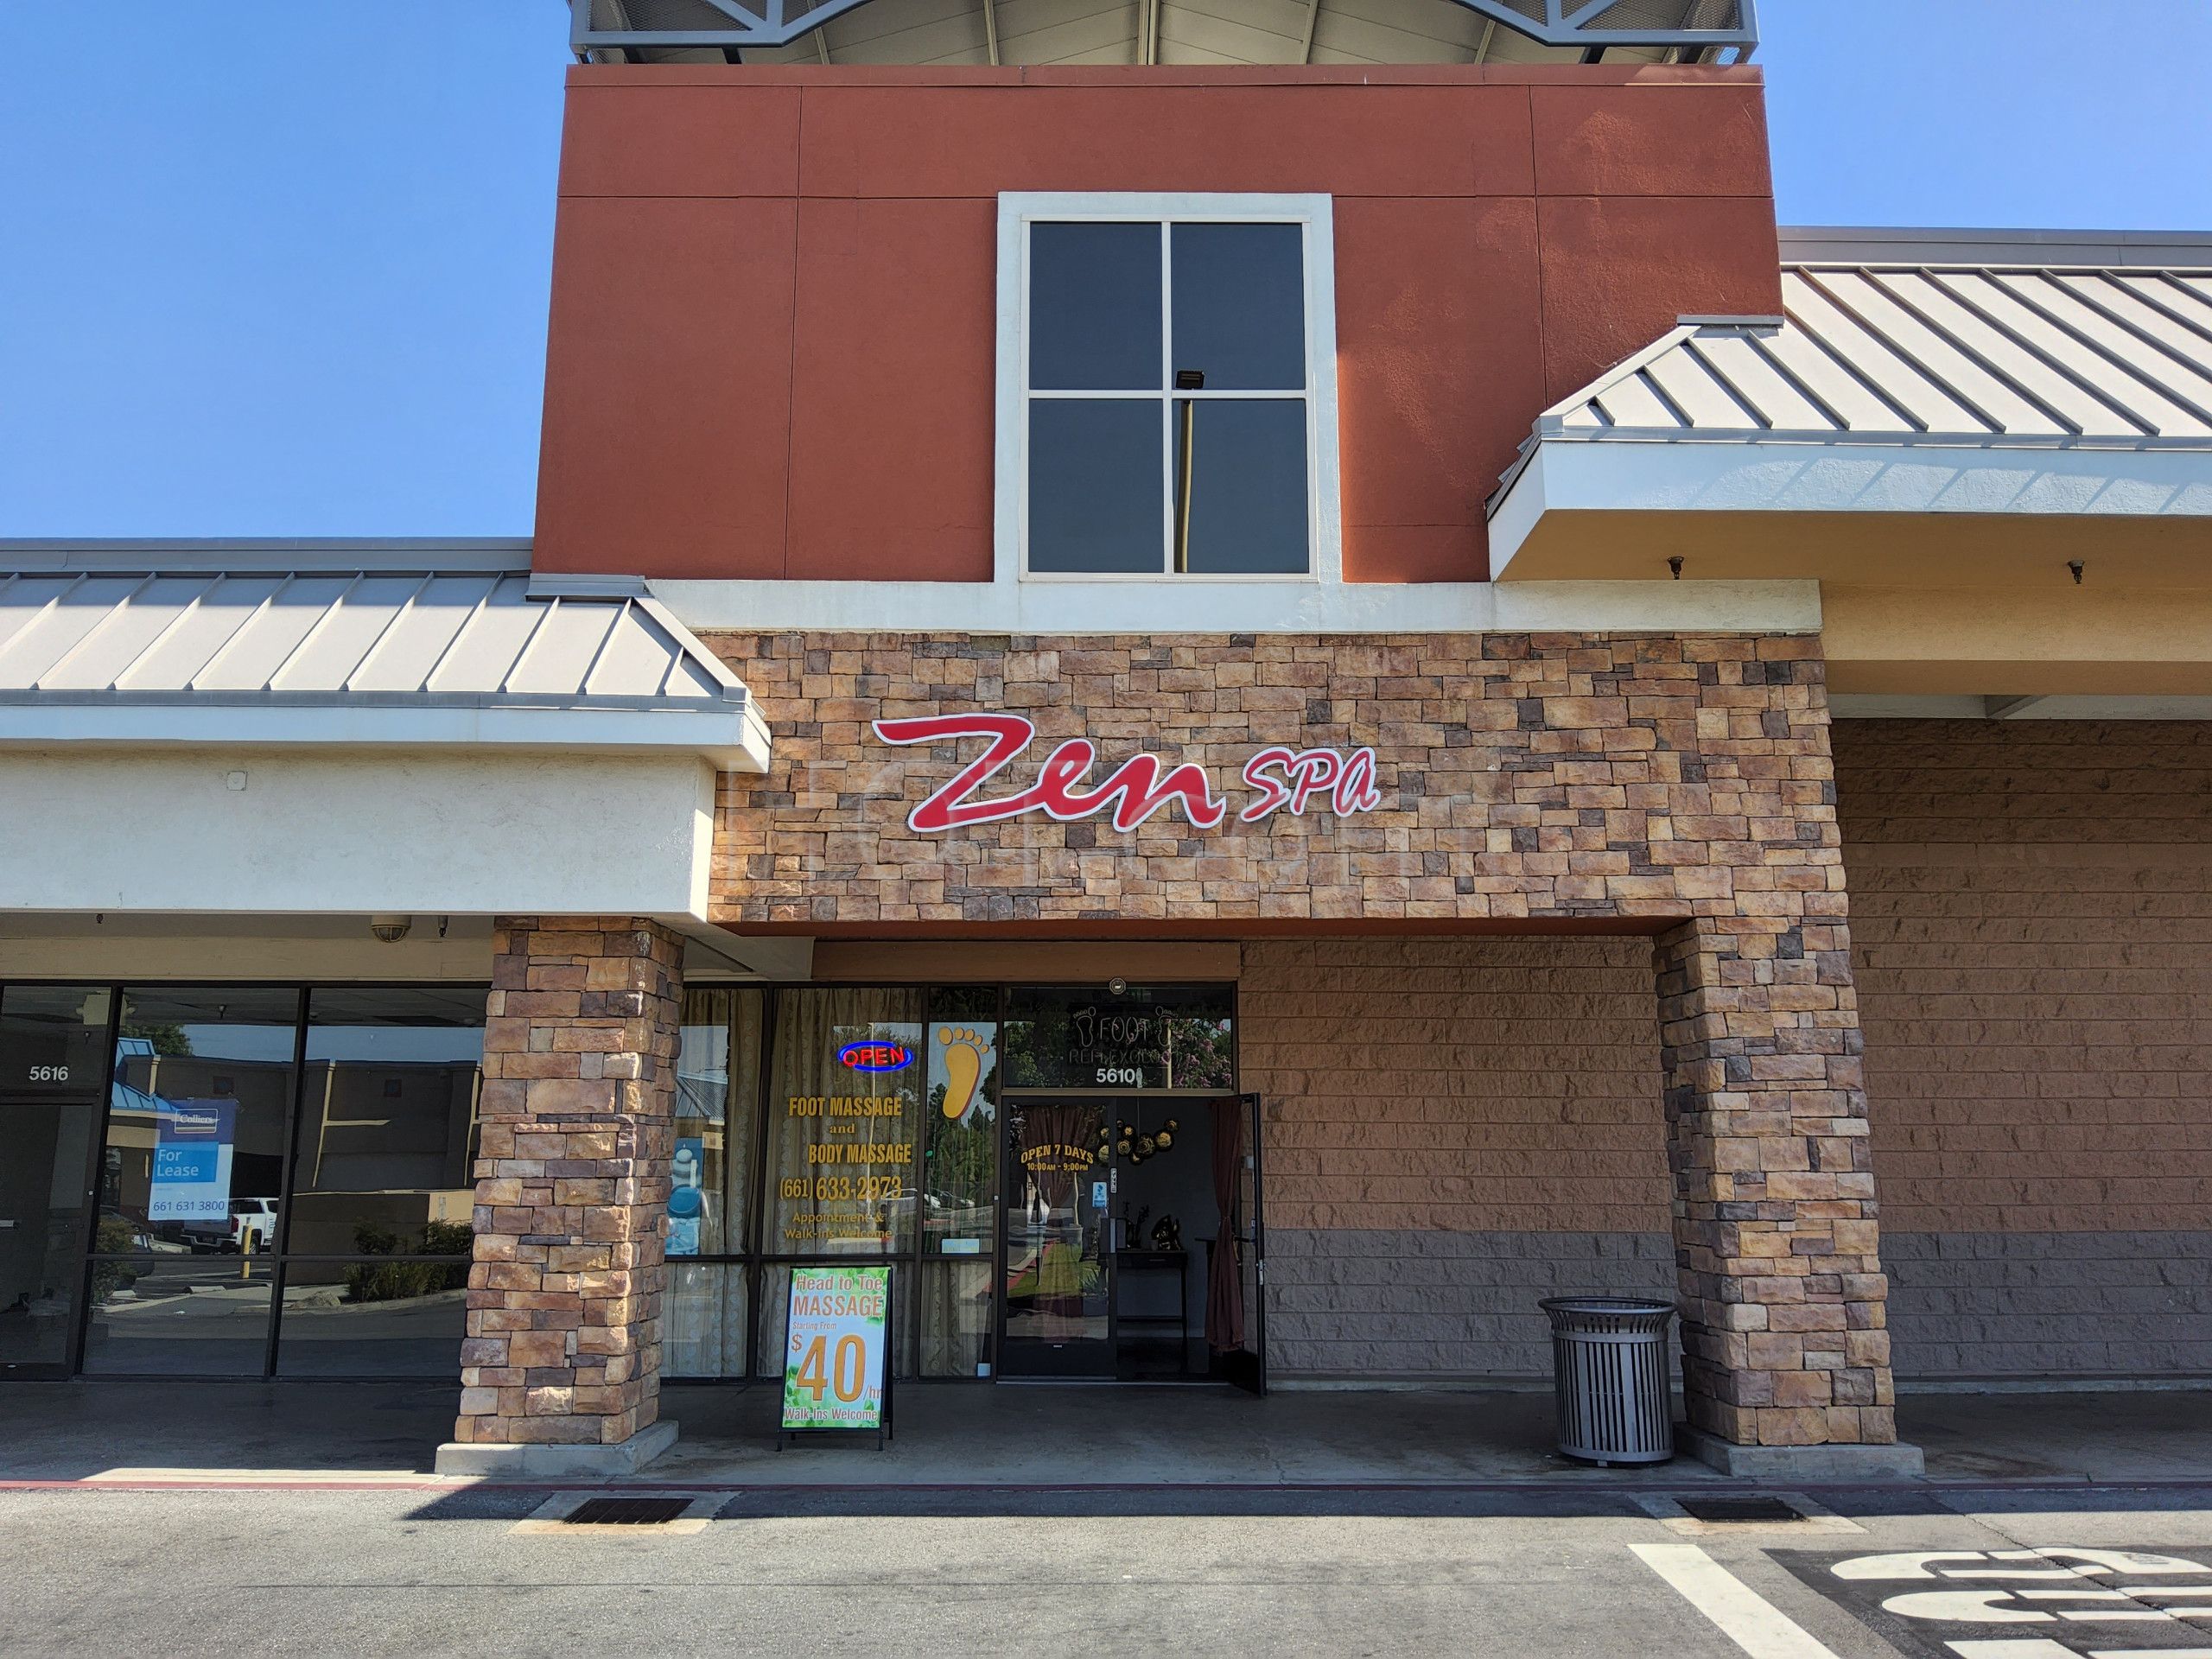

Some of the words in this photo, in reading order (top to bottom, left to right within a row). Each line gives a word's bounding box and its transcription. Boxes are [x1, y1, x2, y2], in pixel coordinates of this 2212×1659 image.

[871, 713, 1226, 833] Zen
[1100, 1016, 1149, 1042] FOOT
[842, 1046, 906, 1067] OPEN
[29, 1065, 69, 1081] 5616
[1096, 1068, 1135, 1084] 5610
[789, 1096, 825, 1117] FOOT
[830, 1096, 902, 1116] MASSAGE
[829, 1122, 855, 1134] and
[157, 1148, 182, 1162] For
[808, 1143, 843, 1164] BODY
[846, 1143, 912, 1164] MASSAGE
[1020, 1144, 1052, 1164] OPEN
[1054, 1144, 1062, 1156] 7
[1064, 1144, 1094, 1164] DAYS
[156, 1164, 200, 1177] Lease
[779, 1177, 813, 1200] (661)
[816, 1175, 902, 1201] 633-2973
[153, 1201, 172, 1211] 661
[176, 1201, 194, 1211] 631
[199, 1200, 225, 1211] 3800
[874, 1211, 885, 1223] &
[839, 1226, 893, 1238] Welcome
[796, 1274, 833, 1291] Head
[839, 1274, 853, 1291] to
[858, 1274, 882, 1291] Toe
[793, 1295, 882, 1317] MASSAGE
[792, 1321, 818, 1331] Starting
[820, 1321, 836, 1331] From
[785, 1407, 828, 1421] Walk-Ins
[832, 1407, 878, 1421] Welcome
